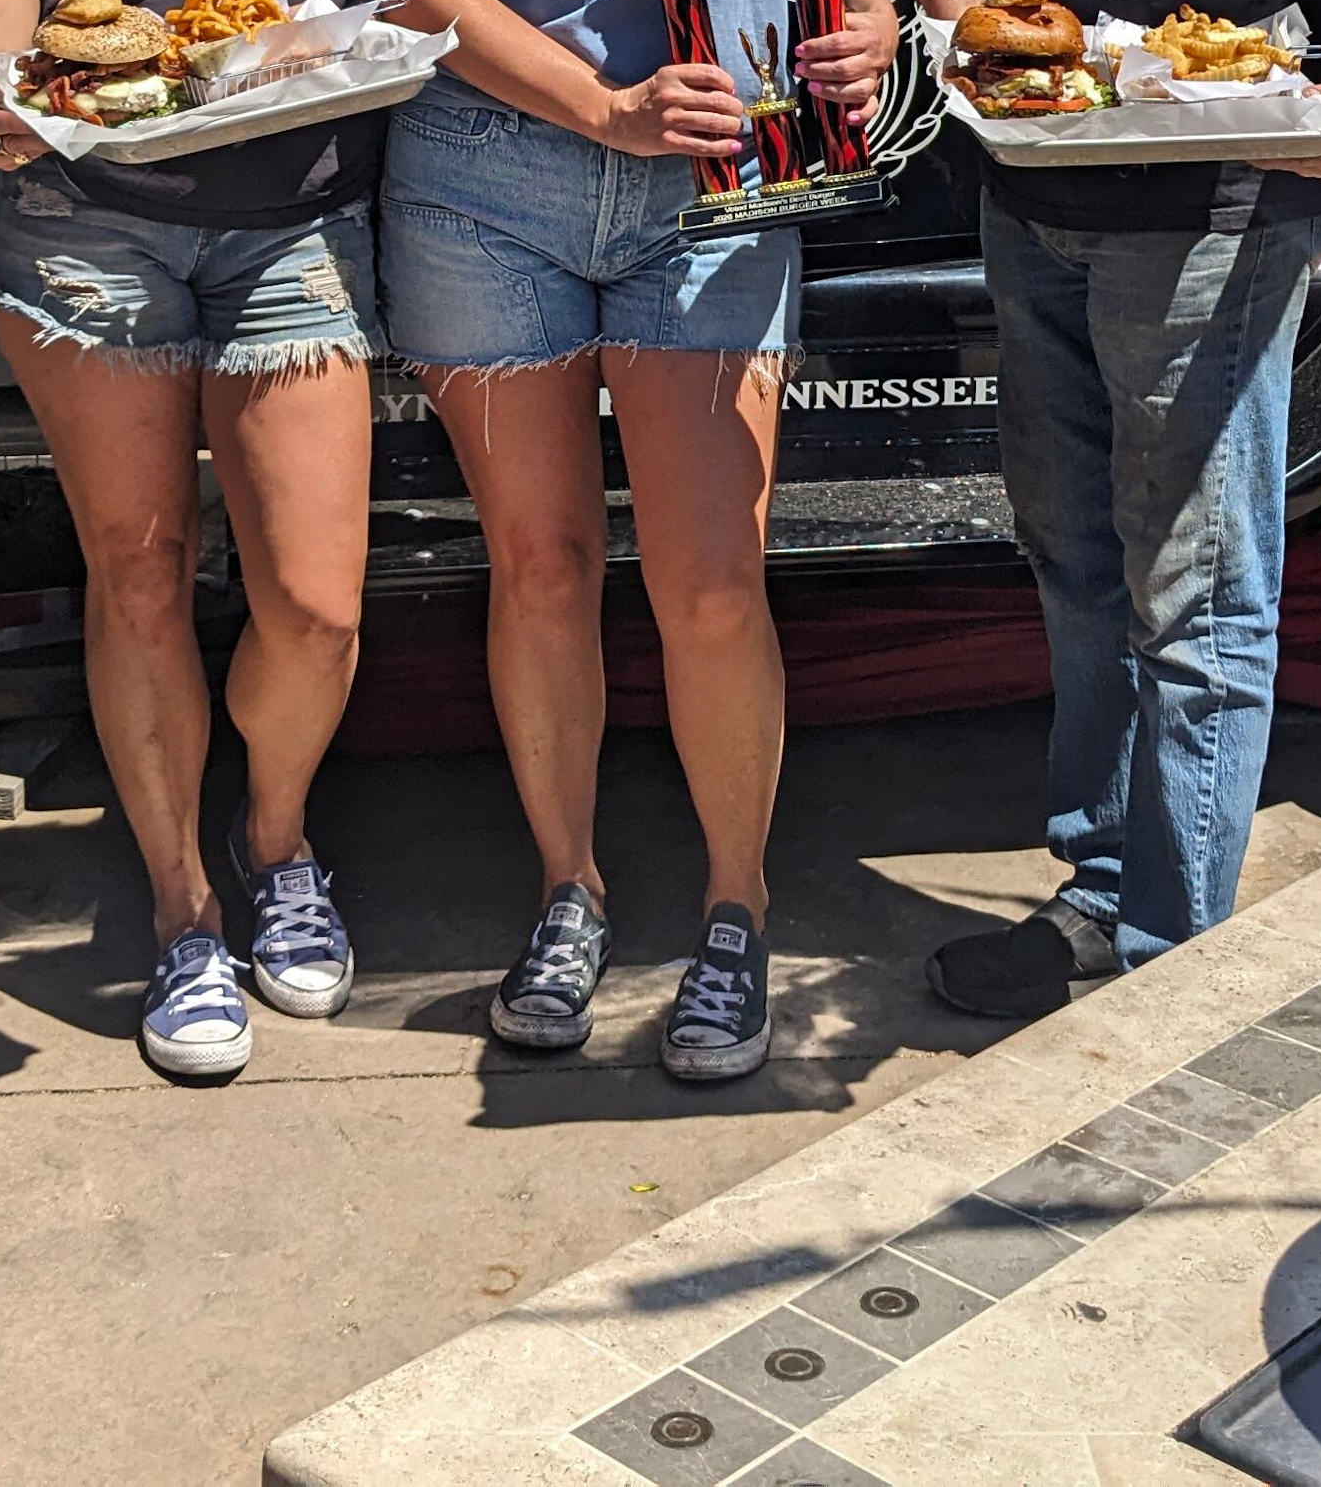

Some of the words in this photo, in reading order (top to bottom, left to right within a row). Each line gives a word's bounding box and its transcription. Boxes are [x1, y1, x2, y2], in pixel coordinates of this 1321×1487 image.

[735, 206, 778, 220] MADISON
[779, 199, 819, 213] BURGER
[820, 196, 848, 206] WEEK
[809, 190, 836, 202] Burger
[780, 375, 999, 410] NNESSEE
